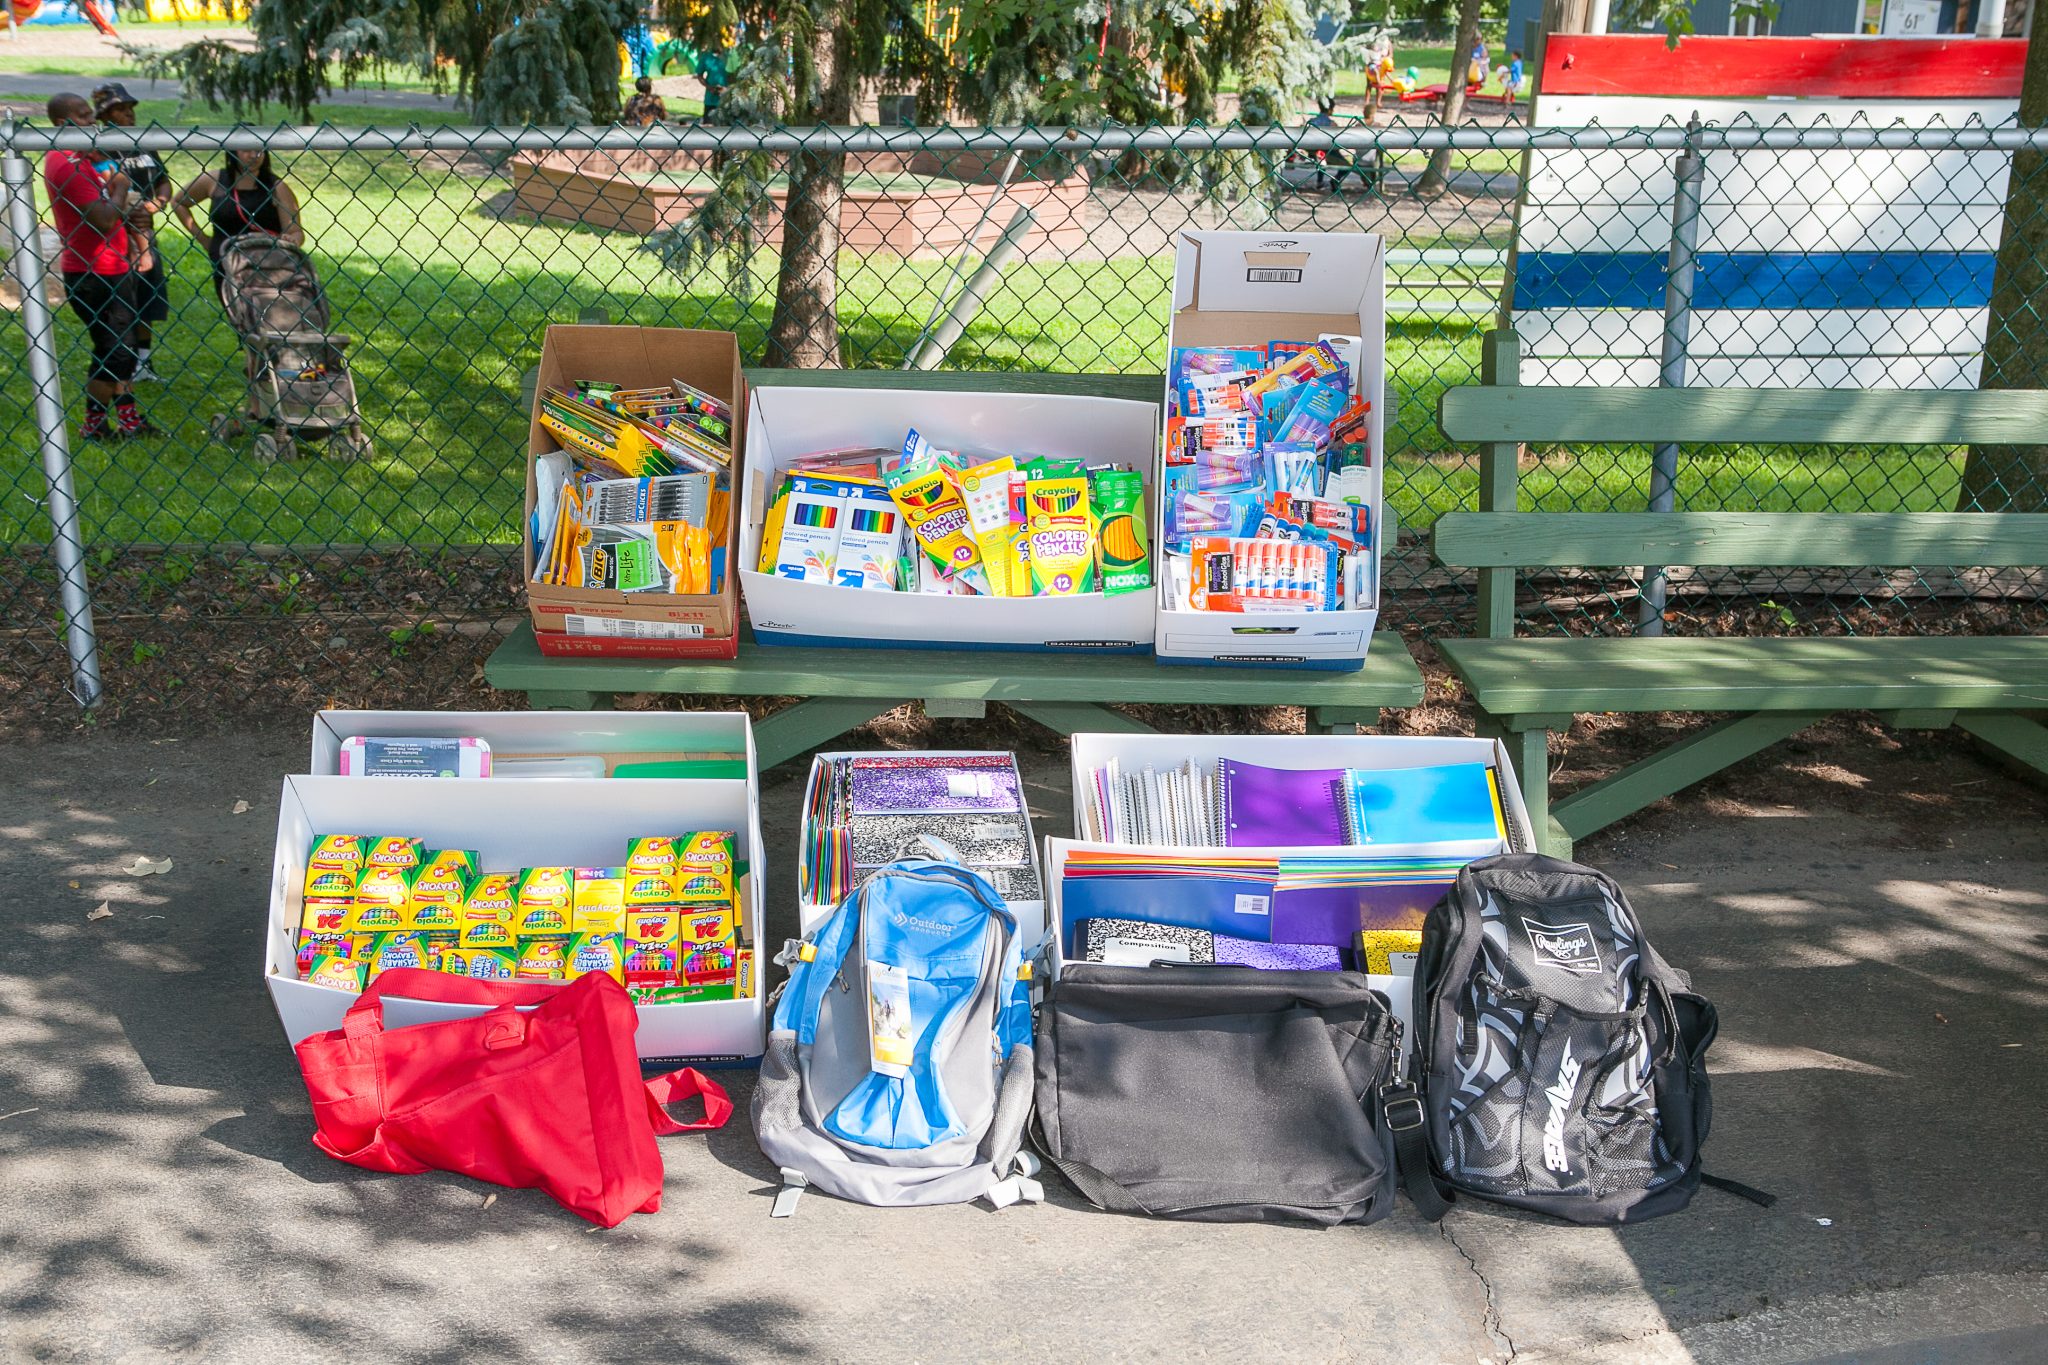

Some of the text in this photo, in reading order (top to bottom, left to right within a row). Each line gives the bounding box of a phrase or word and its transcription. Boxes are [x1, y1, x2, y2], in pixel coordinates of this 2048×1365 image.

[1904, 13, 1919, 30] 61
[542, 404, 552, 414] 10
[1031, 469, 1044, 480] 12
[889, 477, 903, 489] 12
[902, 480, 940, 498] Crayola
[1036, 486, 1077, 496] Crayola
[916, 508, 967, 535] COLORED
[784, 530, 808, 538] colored
[924, 516, 970, 543] PENCILS
[866, 538, 889, 546] pencils
[1031, 530, 1088, 545] COLORED
[1194, 538, 1204, 550] 12
[956, 548, 971, 560] 12
[1036, 542, 1086, 558] PENCILS
[593, 550, 604, 578] BIC
[620, 550, 634, 583] Xtra Life
[1056, 578, 1070, 588] 12
[649, 842, 659, 850] 24
[318, 850, 358, 860] CRAYONS
[373, 852, 414, 864] CRAYONS
[634, 854, 674, 864] CRAYONS
[686, 852, 726, 862] CRAYONS
[314, 884, 350, 892] Crayola
[362, 884, 404, 894] CRAYONS
[418, 881, 460, 891] CRAYONS
[526, 884, 567, 894] CRAYONS
[634, 889, 670, 898] Crayola
[686, 888, 722, 896] Crayola
[470, 899, 512, 910] CRAYONS
[577, 903, 621, 912] Crayons
[315, 908, 348, 916] Crayons
[317, 914, 342, 930] 24
[360, 918, 399, 926] Crayola
[416, 917, 454, 926] Crayola
[636, 916, 669, 924] Crayons
[690, 916, 723, 926] Crayons
[910, 916, 953, 932] Outdoor
[525, 922, 563, 930] Crayola
[640, 923, 664, 938] 24
[696, 923, 720, 938] 24
[910, 926, 950, 937] PRODUCTS
[468, 934, 506, 943] Crayola
[591, 936, 601, 944] 24
[1118, 940, 1176, 951] Composition
[1535, 933, 1588, 958] Rawlings
[578, 952, 609, 960] CRAYONS
[378, 958, 420, 968] WASHABLE
[522, 958, 564, 968] CRAYONS
[572, 958, 614, 968] WASHABLE
[741, 962, 749, 988] Crayons
[314, 974, 357, 990] CRAYONS
[638, 994, 656, 1005] 64
[1542, 1036, 1582, 1173] SAVAGE
